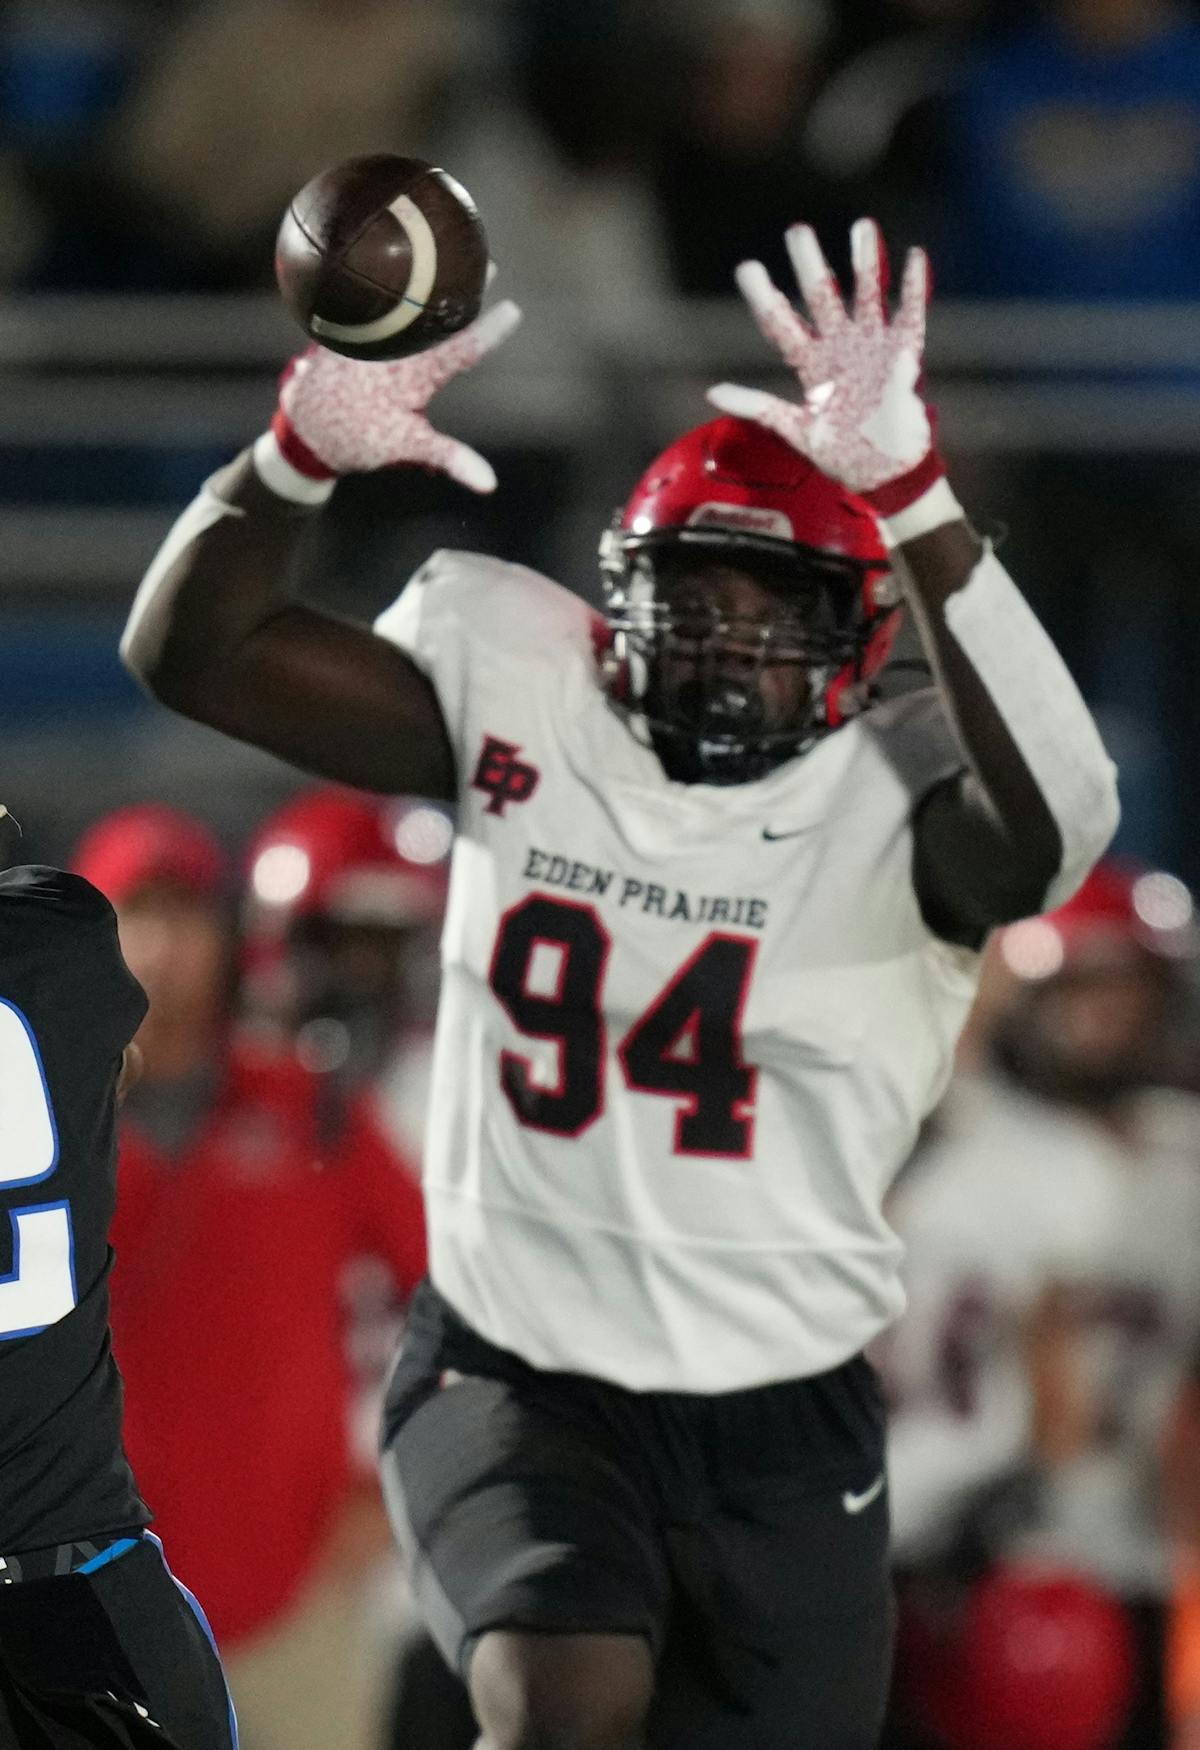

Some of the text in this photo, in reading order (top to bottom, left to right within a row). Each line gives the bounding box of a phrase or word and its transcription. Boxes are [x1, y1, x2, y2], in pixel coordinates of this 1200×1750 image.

[522, 847, 769, 929] EDEN PRAIRIE
[487, 889, 759, 1161] 94
